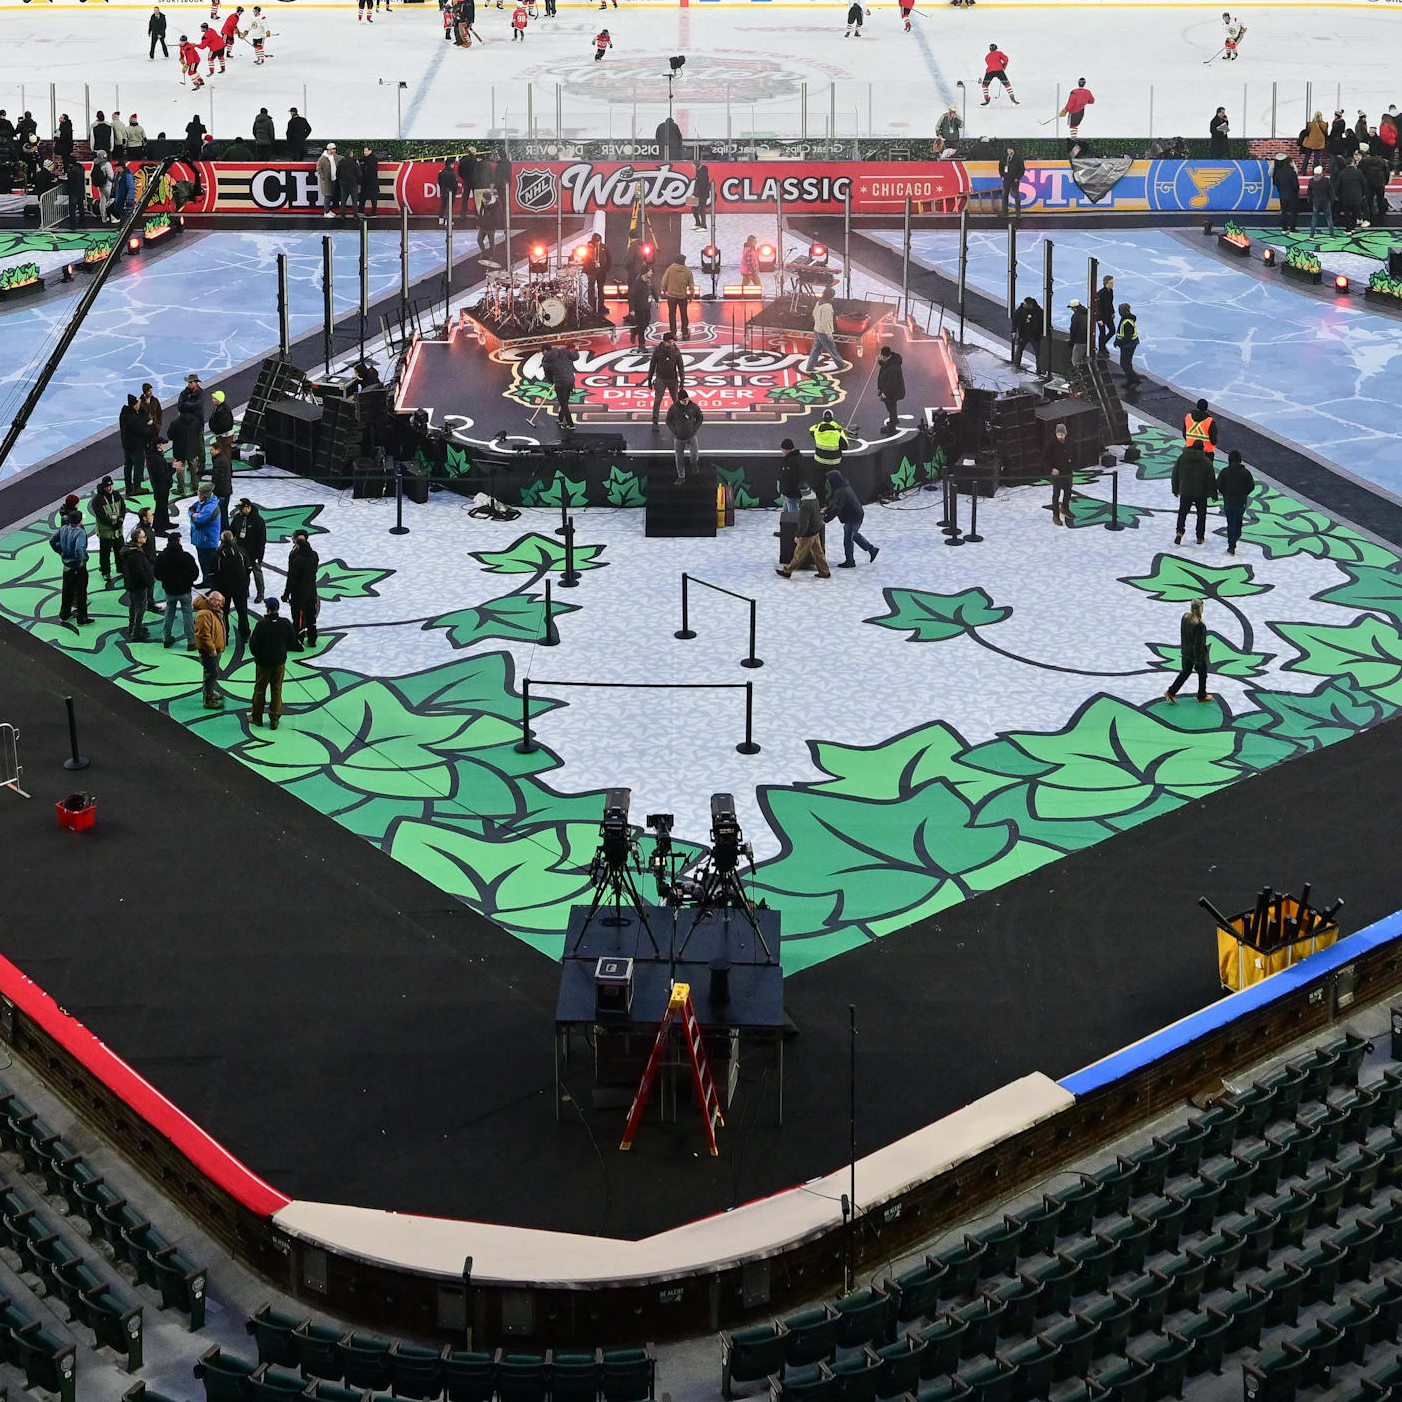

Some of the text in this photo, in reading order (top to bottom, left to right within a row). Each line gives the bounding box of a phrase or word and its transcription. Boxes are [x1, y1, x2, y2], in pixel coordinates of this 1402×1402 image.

[524, 177, 550, 202] NHL
[722, 178, 851, 200] CLASSIC
[872, 182, 932, 196] CHICAGO
